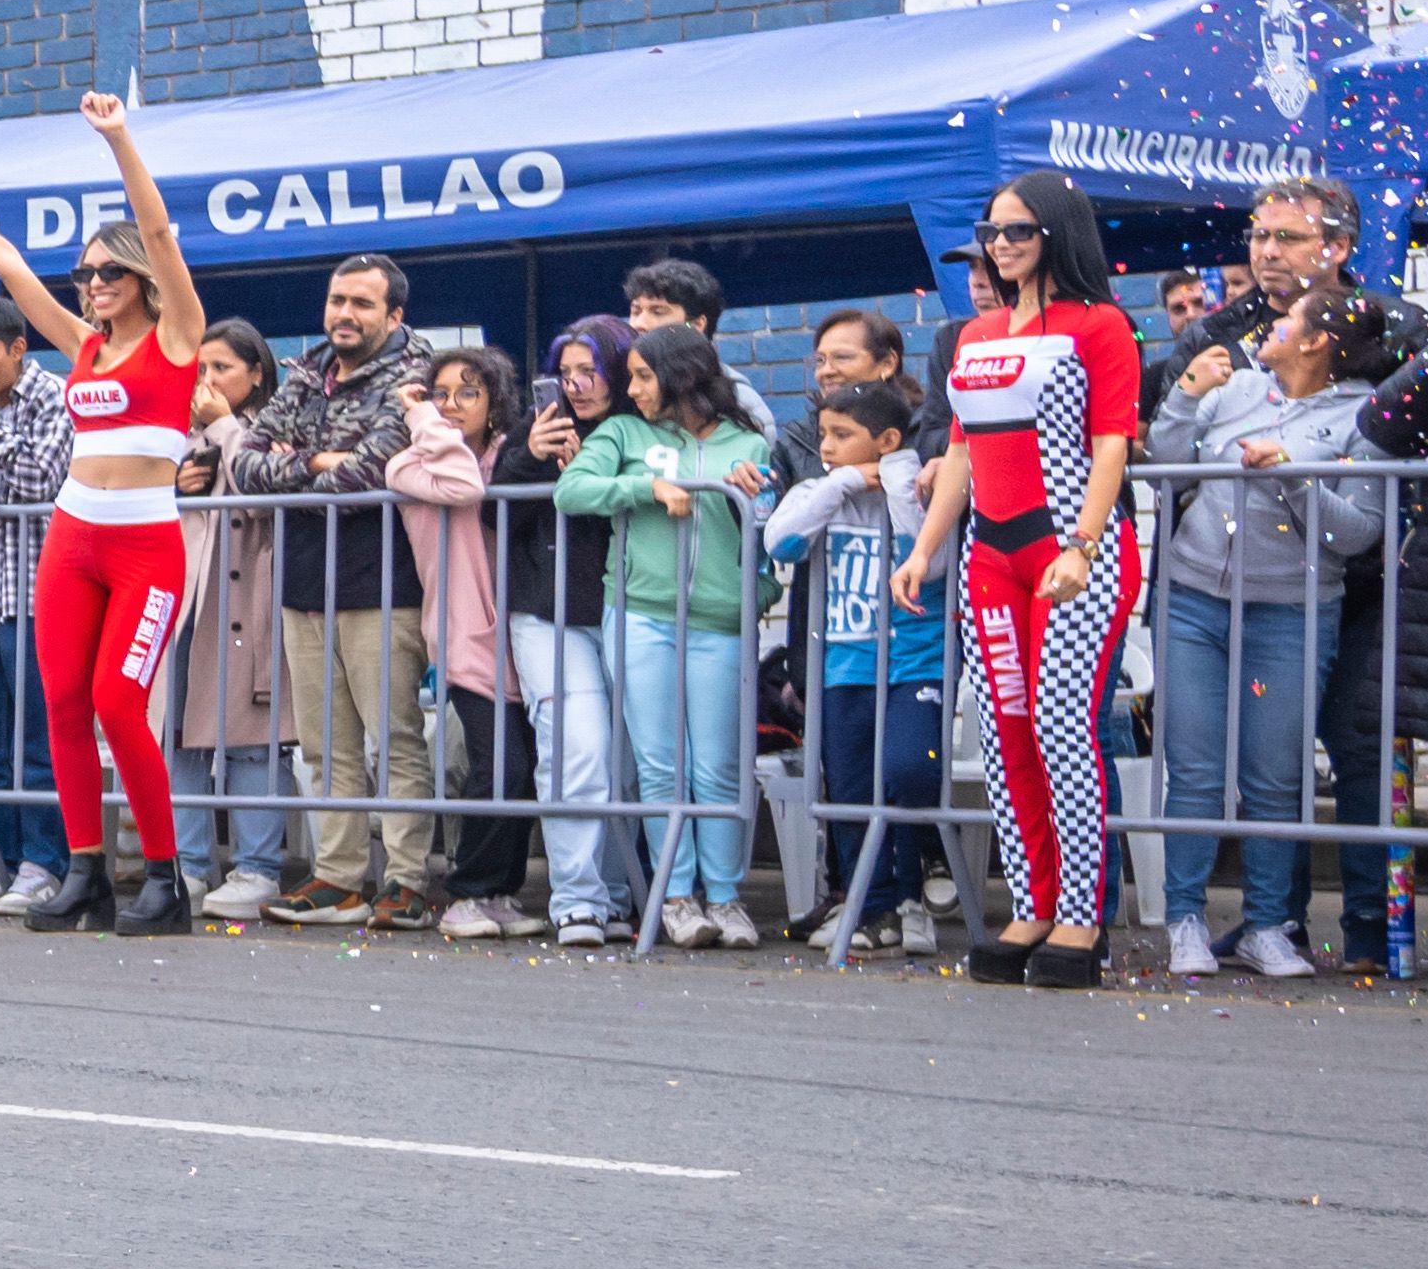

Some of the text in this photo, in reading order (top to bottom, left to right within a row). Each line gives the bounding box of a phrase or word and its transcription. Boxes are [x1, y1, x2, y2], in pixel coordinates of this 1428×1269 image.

[1048, 119, 1314, 184] MUNICIPALIDAD
[26, 190, 180, 250] DE
[207, 151, 565, 234] CALLAO
[73, 389, 122, 406] AMALIE
[121, 585, 166, 680] ONLY THE BEST
[982, 603, 1029, 718] AMALIE
